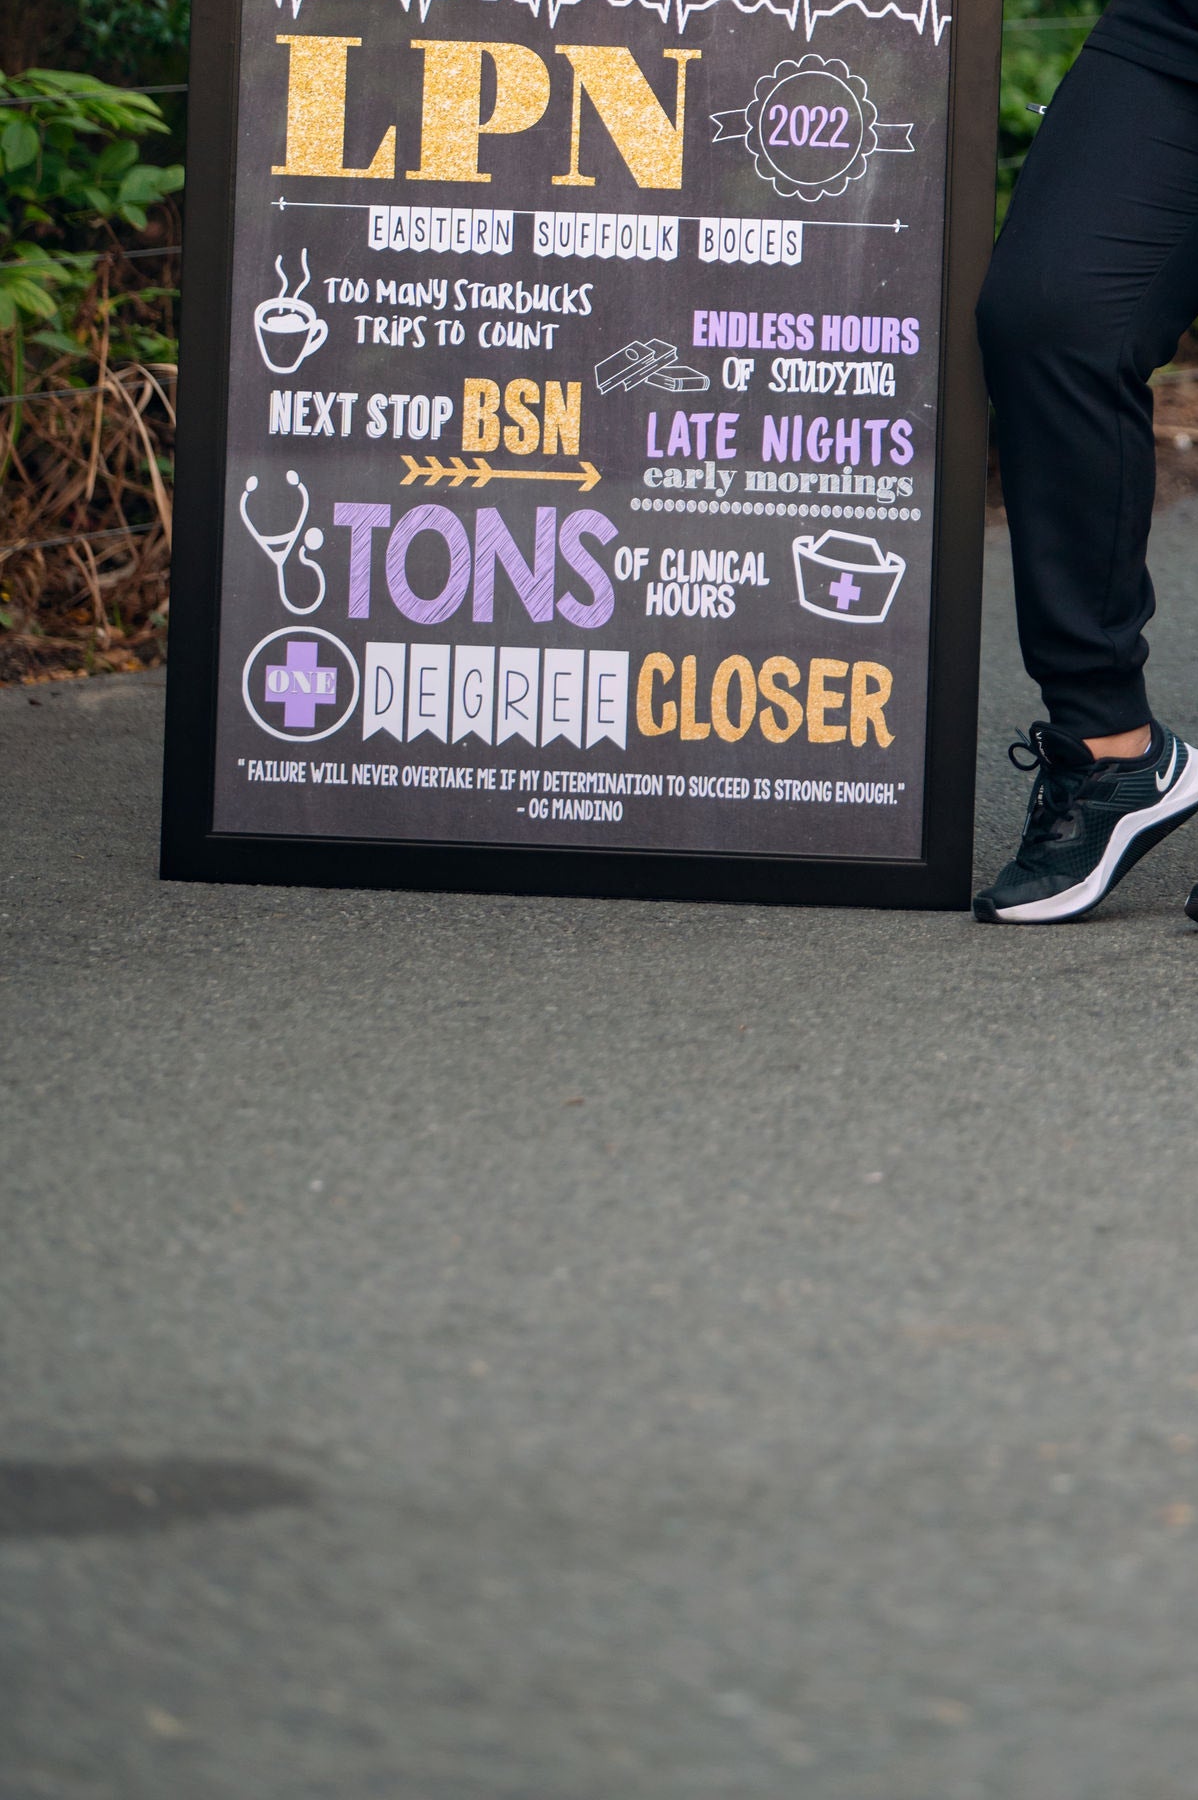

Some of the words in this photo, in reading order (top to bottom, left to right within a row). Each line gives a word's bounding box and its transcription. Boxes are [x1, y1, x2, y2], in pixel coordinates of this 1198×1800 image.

[270, 34, 703, 190] LPN
[768, 104, 850, 150] 2022
[372, 212, 514, 248] EASTERN
[537, 220, 676, 256] SUFFOLK
[703, 226, 801, 258] BOCES
[323, 277, 370, 304] TOO
[434, 319, 466, 346] TO
[478, 321, 560, 350] COUNT
[692, 309, 815, 351] ENDLESS
[821, 314, 920, 355] HOURS
[722, 356, 755, 390] OF
[768, 357, 896, 397] STUDYING
[269, 390, 358, 437] NEXT
[366, 393, 454, 440] STOP
[462, 378, 582, 456] BSN
[646, 410, 740, 461] LATE
[762, 414, 914, 467] NIGHTS
[643, 461, 737, 497] early
[744, 466, 914, 504] mornings
[333, 502, 619, 629] TONS
[613, 546, 650, 582] OF
[660, 548, 770, 586] CLINICAL
[645, 582, 736, 619] HOURS
[267, 669, 336, 695] ONE
[372, 663, 620, 726] DEGREE
[636, 651, 896, 748] CLOSER
[310, 761, 348, 784] WILL
[351, 763, 399, 787] NEVER
[401, 765, 474, 789] OVERTAKE
[476, 768, 497, 790] ME
[499, 769, 517, 790] IF
[519, 770, 540, 792] MY
[543, 771, 663, 796] DETERMINATION
[666, 775, 686, 797] TO
[688, 776, 750, 800] SUCCEED
[753, 778, 771, 800] IS
[774, 779, 832, 802] STRONG
[528, 798, 549, 819] OG
[551, 799, 624, 822] MANDINO
